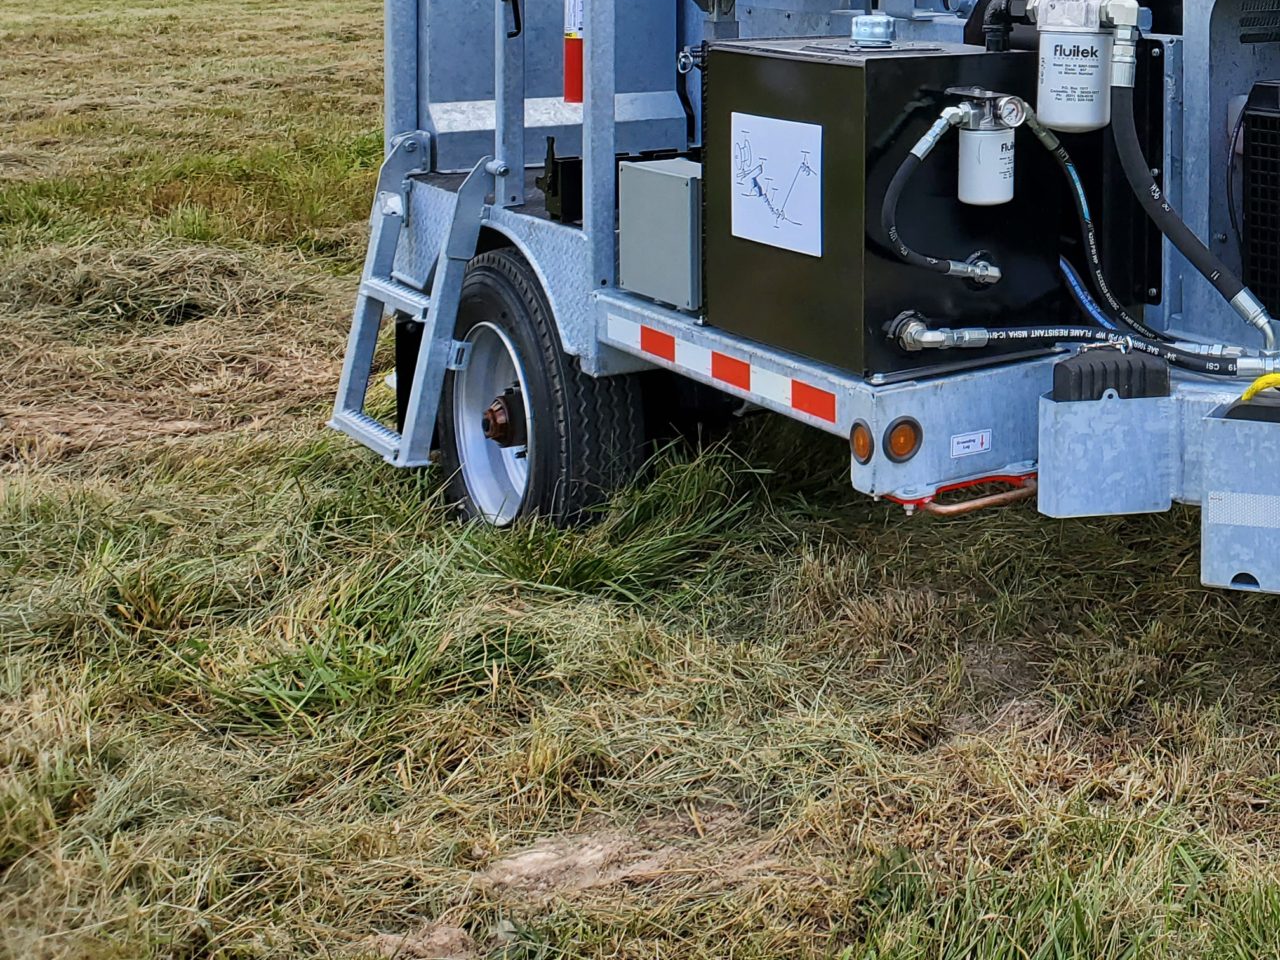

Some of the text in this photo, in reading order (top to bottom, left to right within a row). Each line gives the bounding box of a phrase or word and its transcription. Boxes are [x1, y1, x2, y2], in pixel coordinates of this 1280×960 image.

[1008, 330, 1028, 338] MSHA
[1030, 328, 1069, 338] RESISTANT
[1070, 328, 1092, 338] FLAME
[1096, 331, 1106, 340] WP
[1146, 344, 1160, 355] SAE
[1206, 361, 1220, 371] CSI
